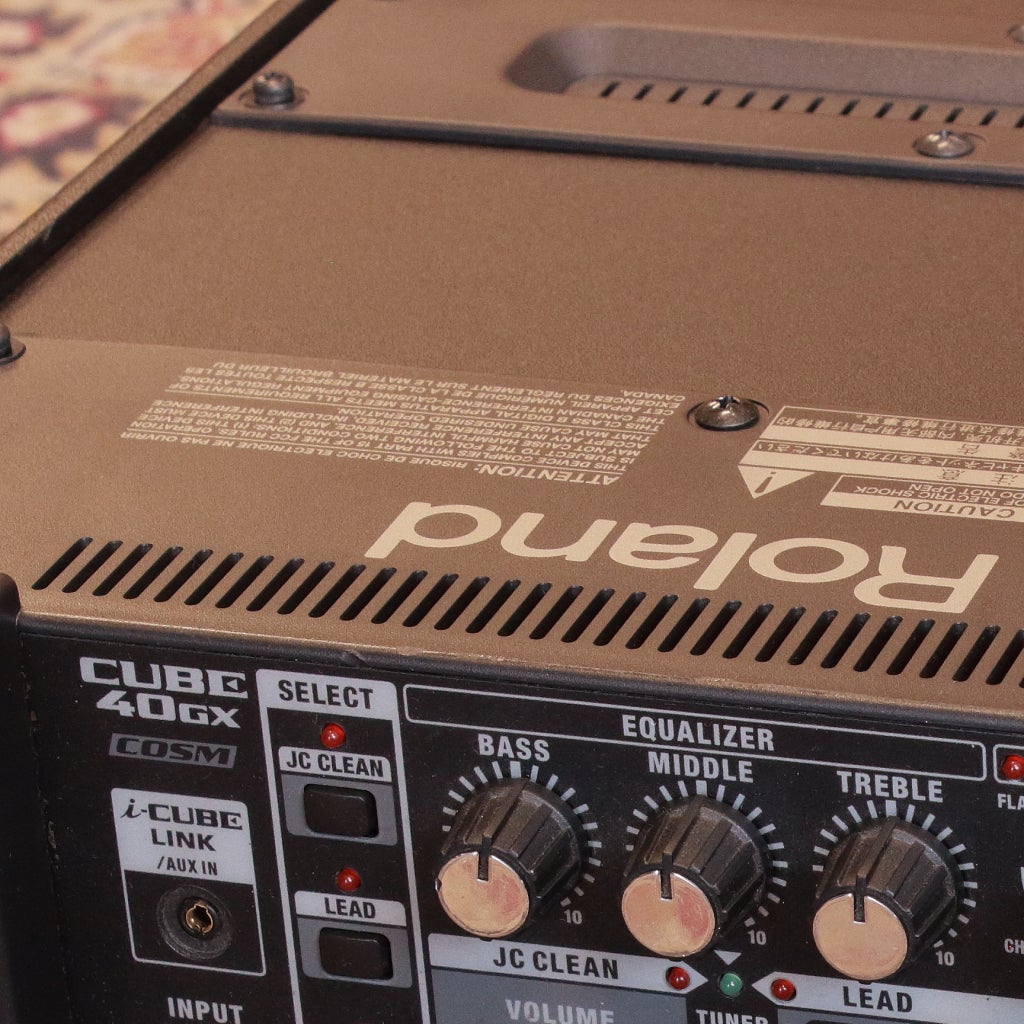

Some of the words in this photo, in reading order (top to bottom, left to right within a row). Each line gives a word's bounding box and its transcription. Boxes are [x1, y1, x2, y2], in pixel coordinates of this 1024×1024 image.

[121, 431, 178, 442] OUVRIR
[182, 436, 210, 445] PAS
[213, 439, 235, 447] NE
[337, 450, 381, 460] CHOC
[386, 454, 407, 462] DE
[410, 456, 468, 468] RISQUE
[537, 457, 591, 468] DEVICE
[475, 463, 620, 486] ATTENTION:
[594, 462, 627, 471] THIS
[854, 486, 913, 496] SHOCK
[909, 483, 956, 493] OPEN
[918, 491, 1000, 504] ELECTRIC
[959, 487, 996, 497] NOT
[895, 500, 1016, 519] CAUTION
[364, 502, 1000, 614] Roland
[79, 657, 249, 699] CUBE
[278, 679, 374, 710] SELECT
[96, 690, 241, 728] 40GX
[622, 714, 774, 751] EQUALIZER
[116, 737, 229, 766] COSM
[478, 733, 550, 761] BASS
[286, 751, 312, 769] JC
[318, 754, 384, 778] CLEAN
[648, 751, 754, 783] MIDDLE
[836, 770, 944, 802] TREBLE
[120, 797, 243, 831] i-CUBE
[151, 828, 216, 852] LINK
[157, 856, 198, 874] /AUX
[202, 861, 218, 876] IN
[324, 898, 376, 919] LEAD
[564, 910, 582, 925] 10
[748, 930, 767, 945] 10
[493, 947, 524, 968] JC
[532, 951, 619, 979] CLEAN
[936, 950, 954, 966] 10
[842, 986, 912, 1013] LEAD
[167, 997, 243, 1024] INPUT
